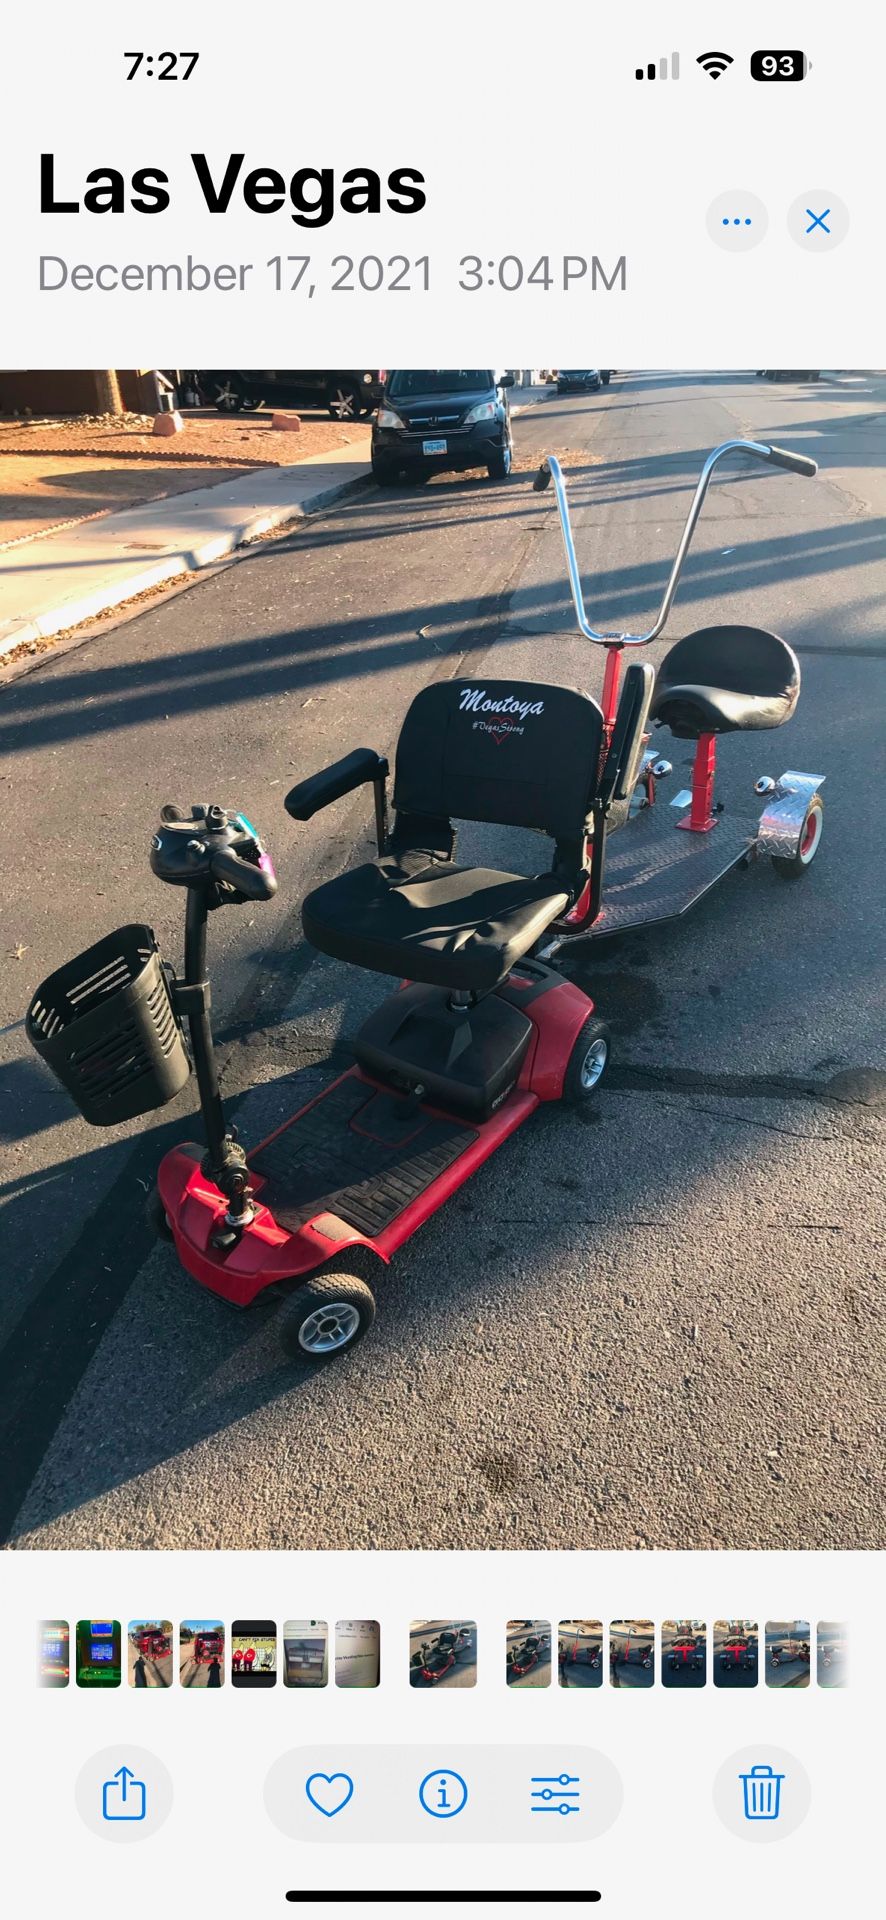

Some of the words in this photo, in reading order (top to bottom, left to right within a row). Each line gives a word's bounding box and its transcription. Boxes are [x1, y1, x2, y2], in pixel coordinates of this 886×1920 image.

[124, 52, 199, 81] 7:27
[761, 55, 795, 77] 93
[40, 153, 171, 215] Las
[190, 153, 427, 229] Vegas
[38, 255, 254, 292] December
[266, 255, 317, 299] 17,
[330, 254, 431, 292] 2021
[459, 688, 545, 721] Montoya
[472, 721, 525, 736] #VegasStrong
